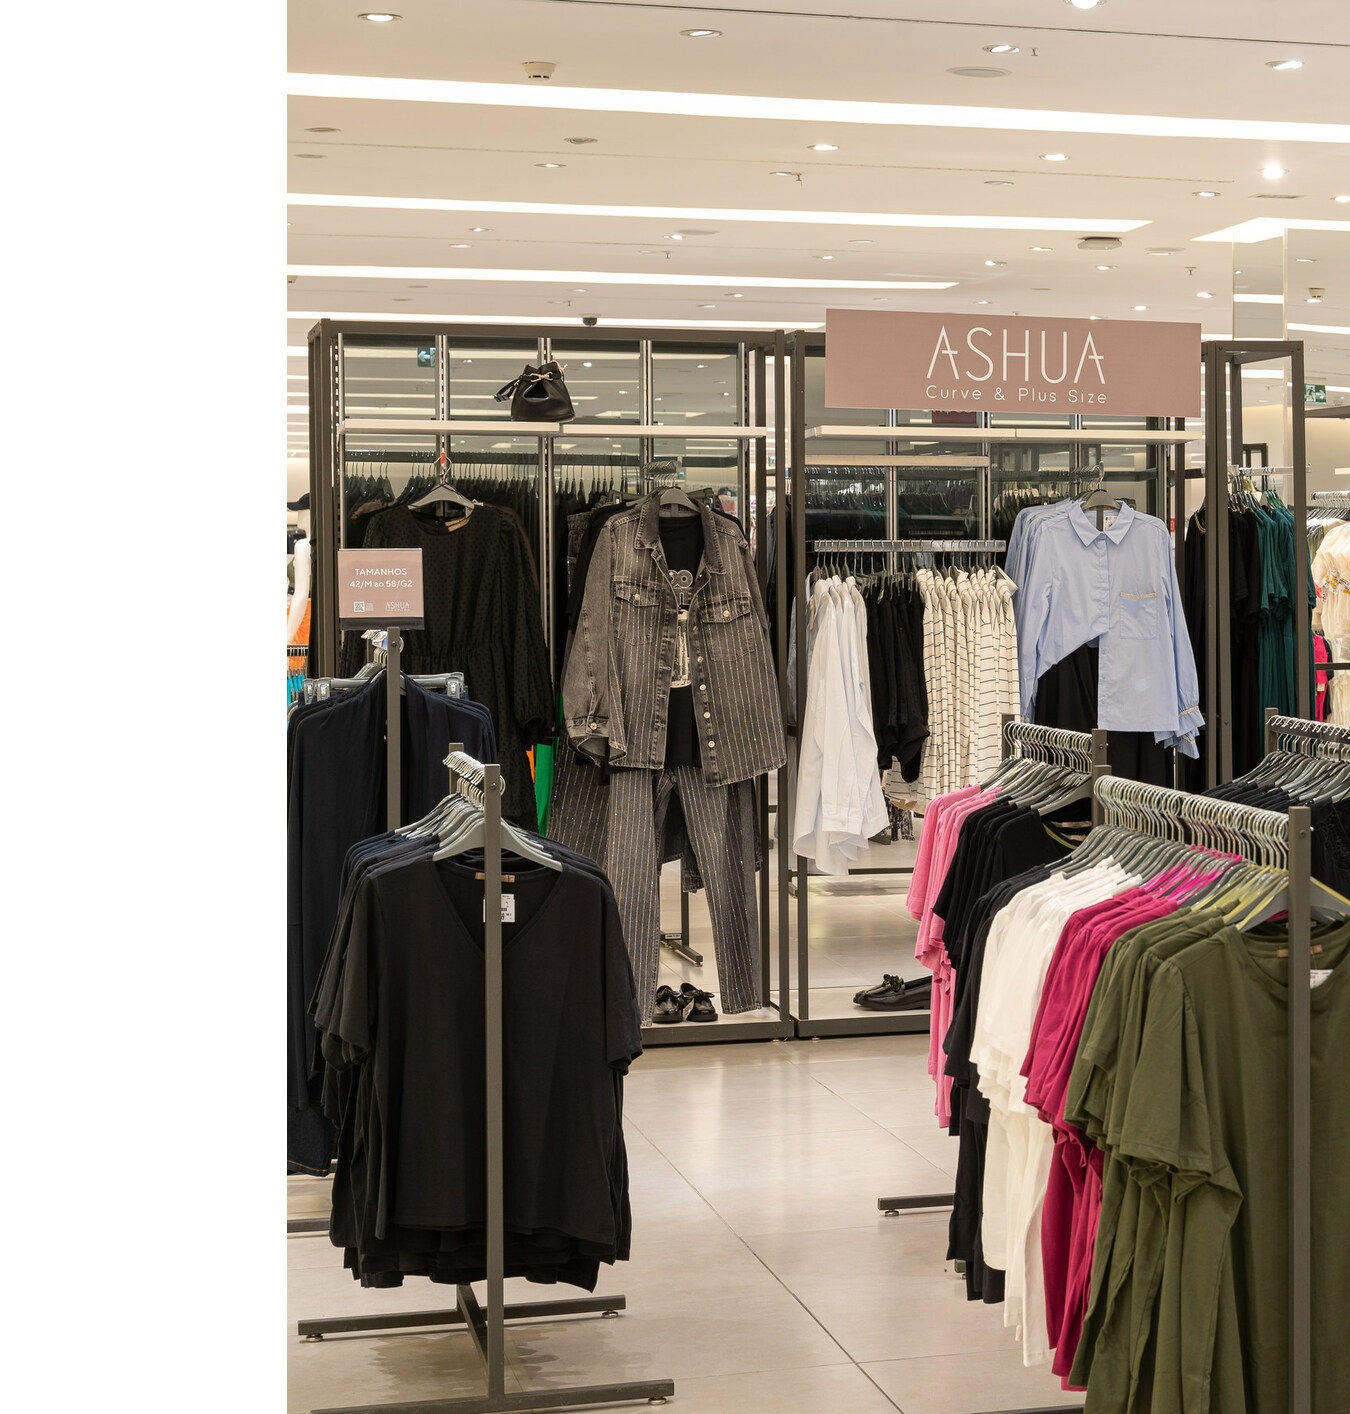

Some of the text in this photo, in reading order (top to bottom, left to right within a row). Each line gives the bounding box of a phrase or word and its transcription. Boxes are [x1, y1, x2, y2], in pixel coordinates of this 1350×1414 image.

[926, 325, 1106, 384] ASHUA
[926, 385, 1107, 404] Curve & Plus Size
[355, 568, 407, 576] TAMANHOS
[349, 580, 373, 589] 42/M
[385, 580, 413, 589] 58/G2
[385, 601, 410, 609] ASHUA
